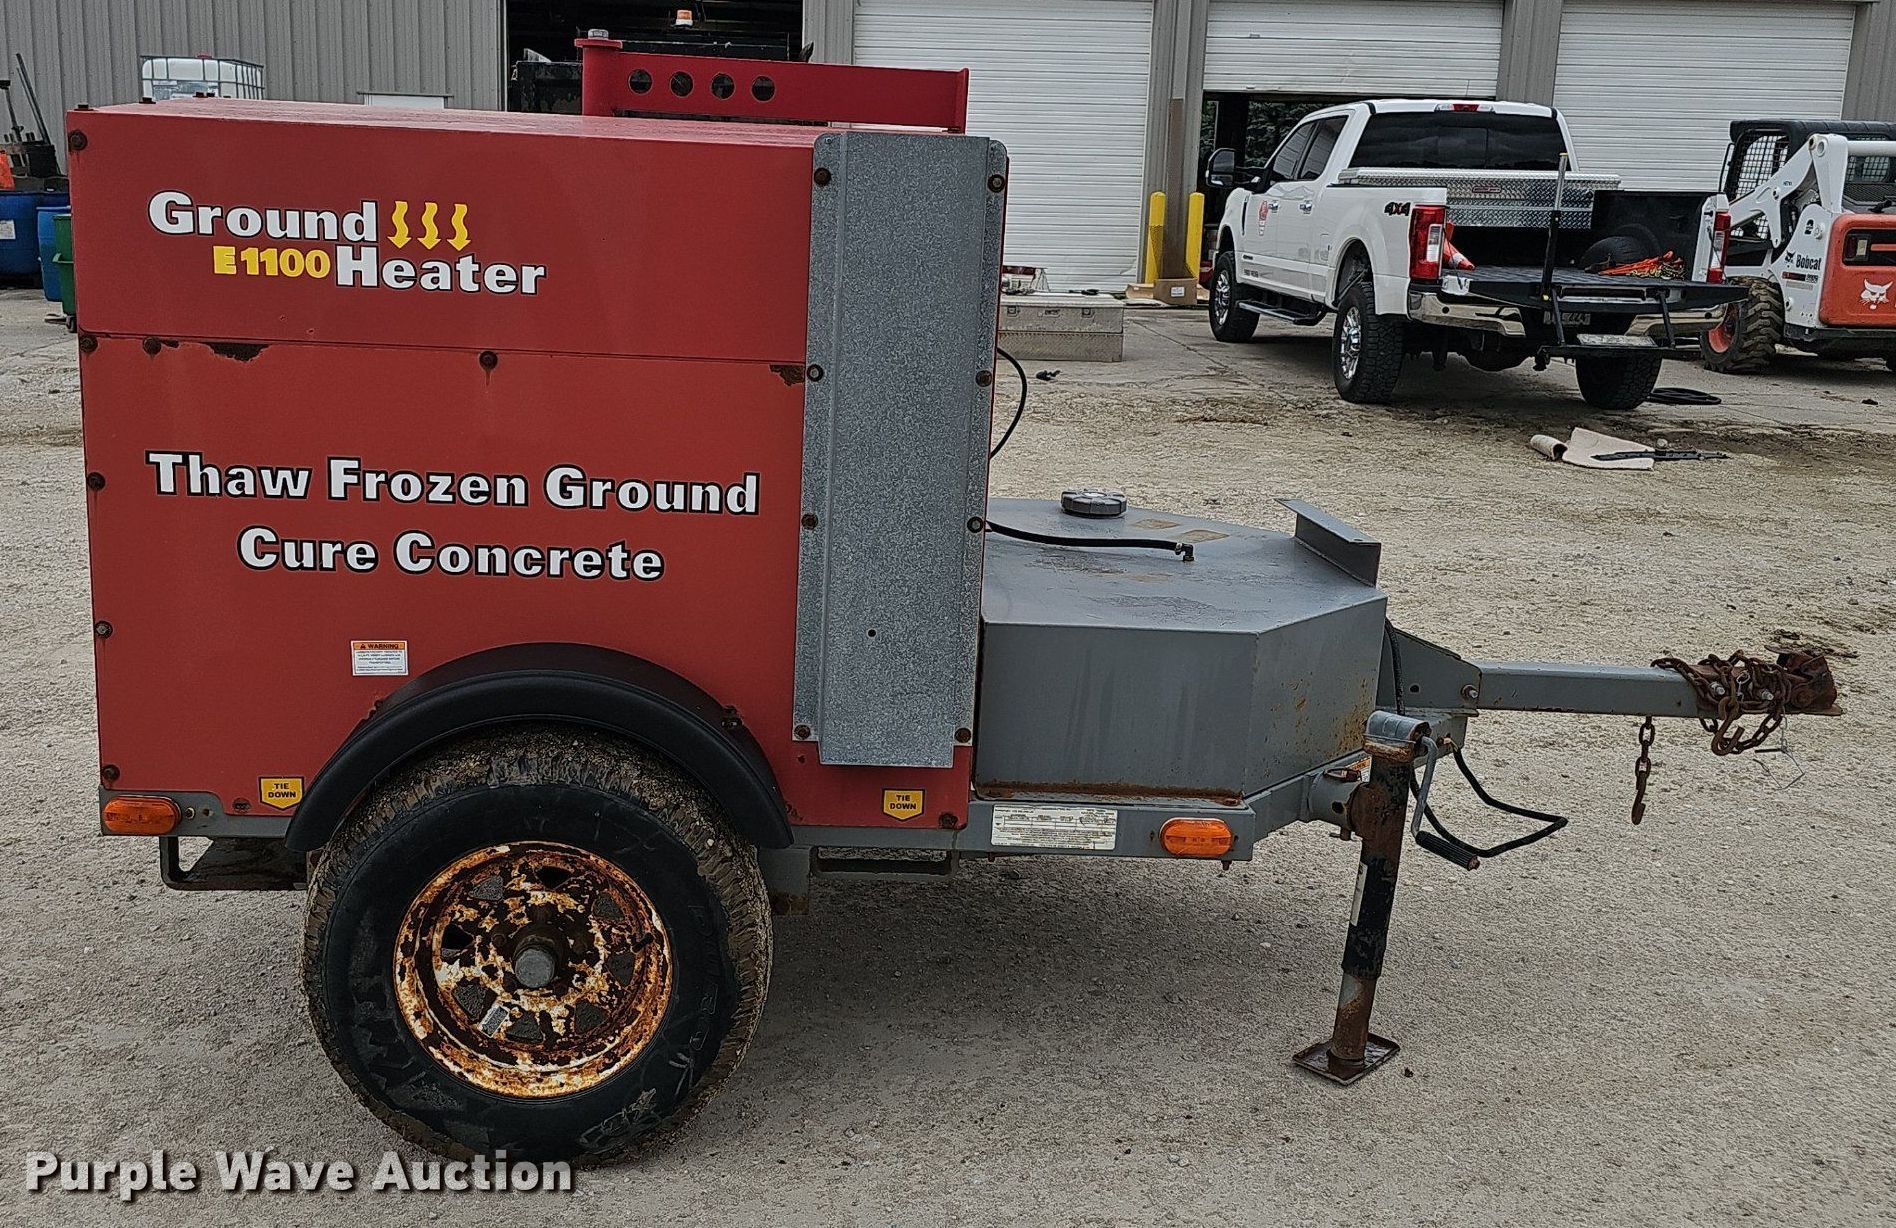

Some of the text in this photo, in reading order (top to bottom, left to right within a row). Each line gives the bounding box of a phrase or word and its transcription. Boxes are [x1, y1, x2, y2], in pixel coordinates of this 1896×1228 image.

[148, 191, 377, 242] Ground
[213, 245, 330, 279] E1100
[336, 245, 546, 294] Heater
[1796, 254, 1822, 271] Bobcat
[145, 450, 760, 515] Thaw Frozen Ground
[237, 525, 665, 581] Cure Concrete
